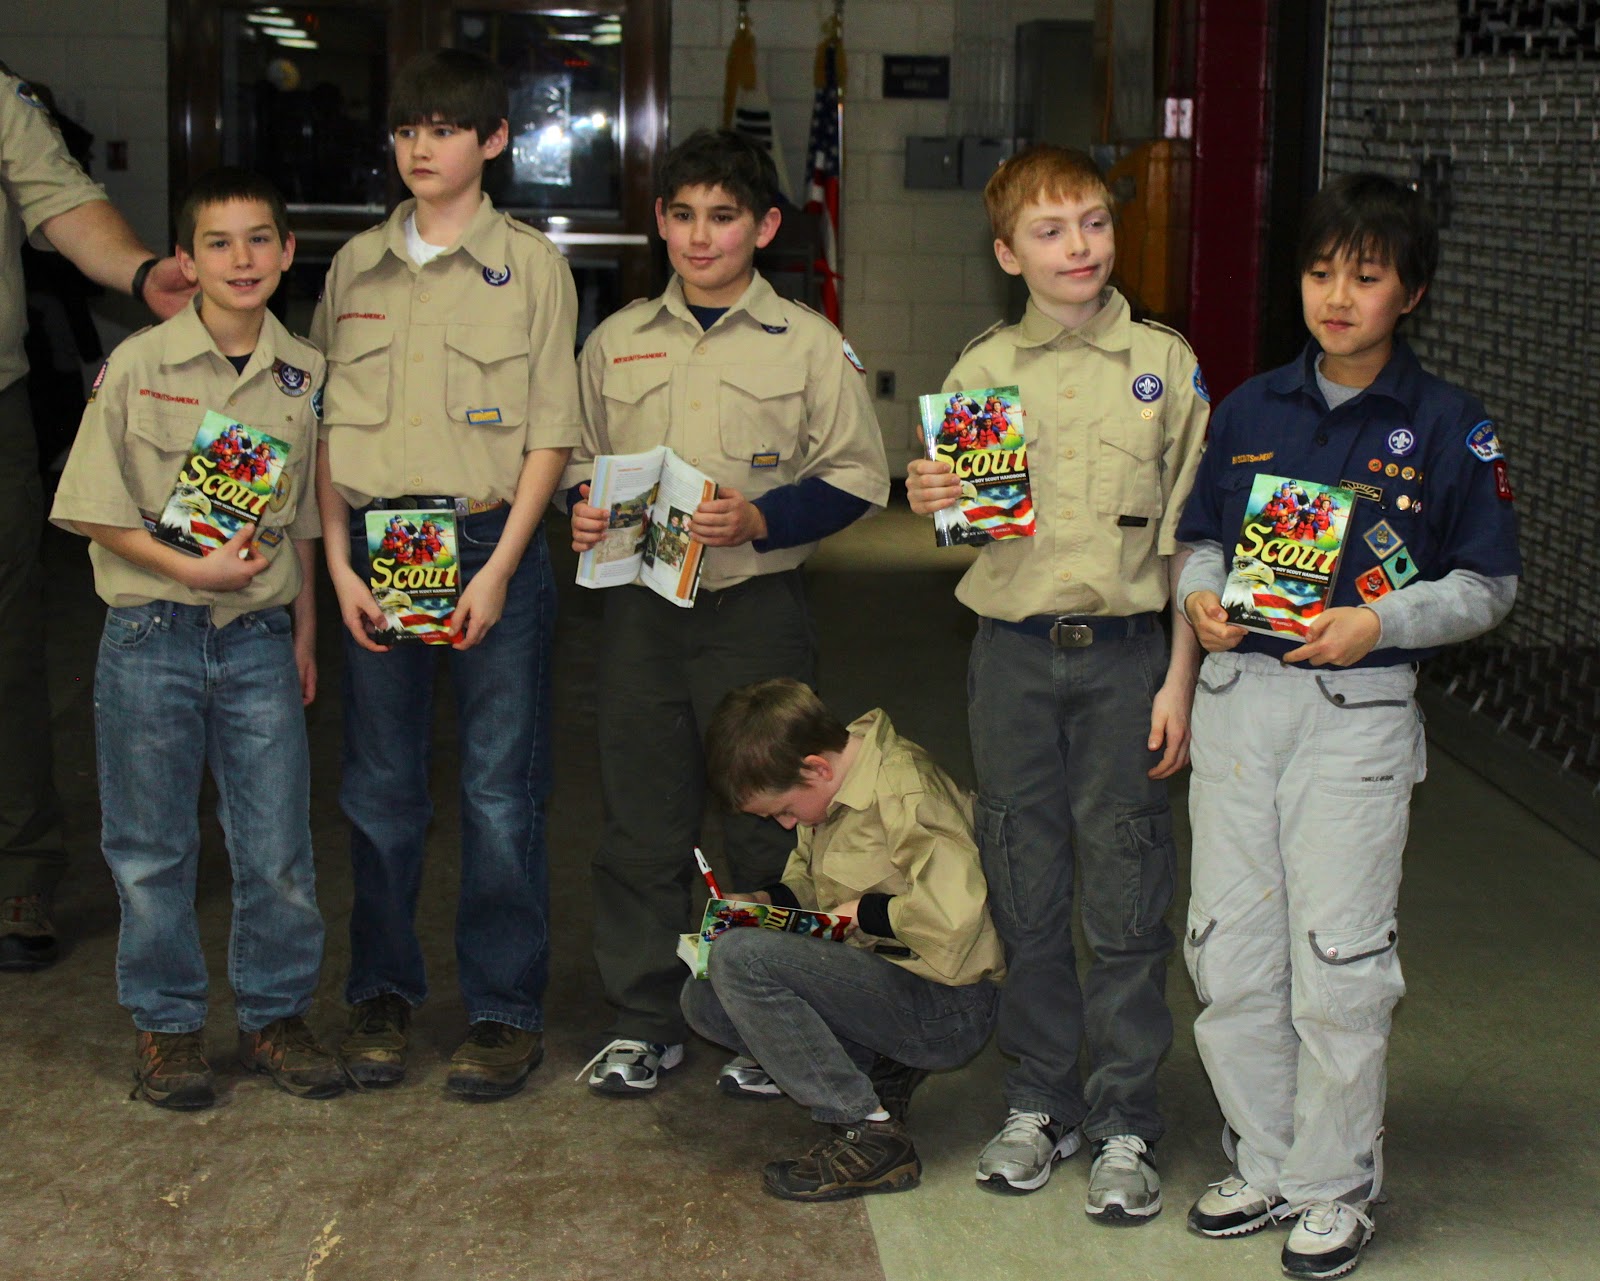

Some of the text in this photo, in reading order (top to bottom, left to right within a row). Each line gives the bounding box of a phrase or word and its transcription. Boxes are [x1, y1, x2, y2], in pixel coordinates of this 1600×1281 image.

[180, 455, 270, 513] Scout
[1000, 472, 1027, 480] HANDBOOK
[1235, 523, 1340, 573] Scout
[370, 558, 458, 588] Scout
[1286, 568, 1302, 576] SCOUT
[1302, 572, 1329, 581] HANDBOOK
